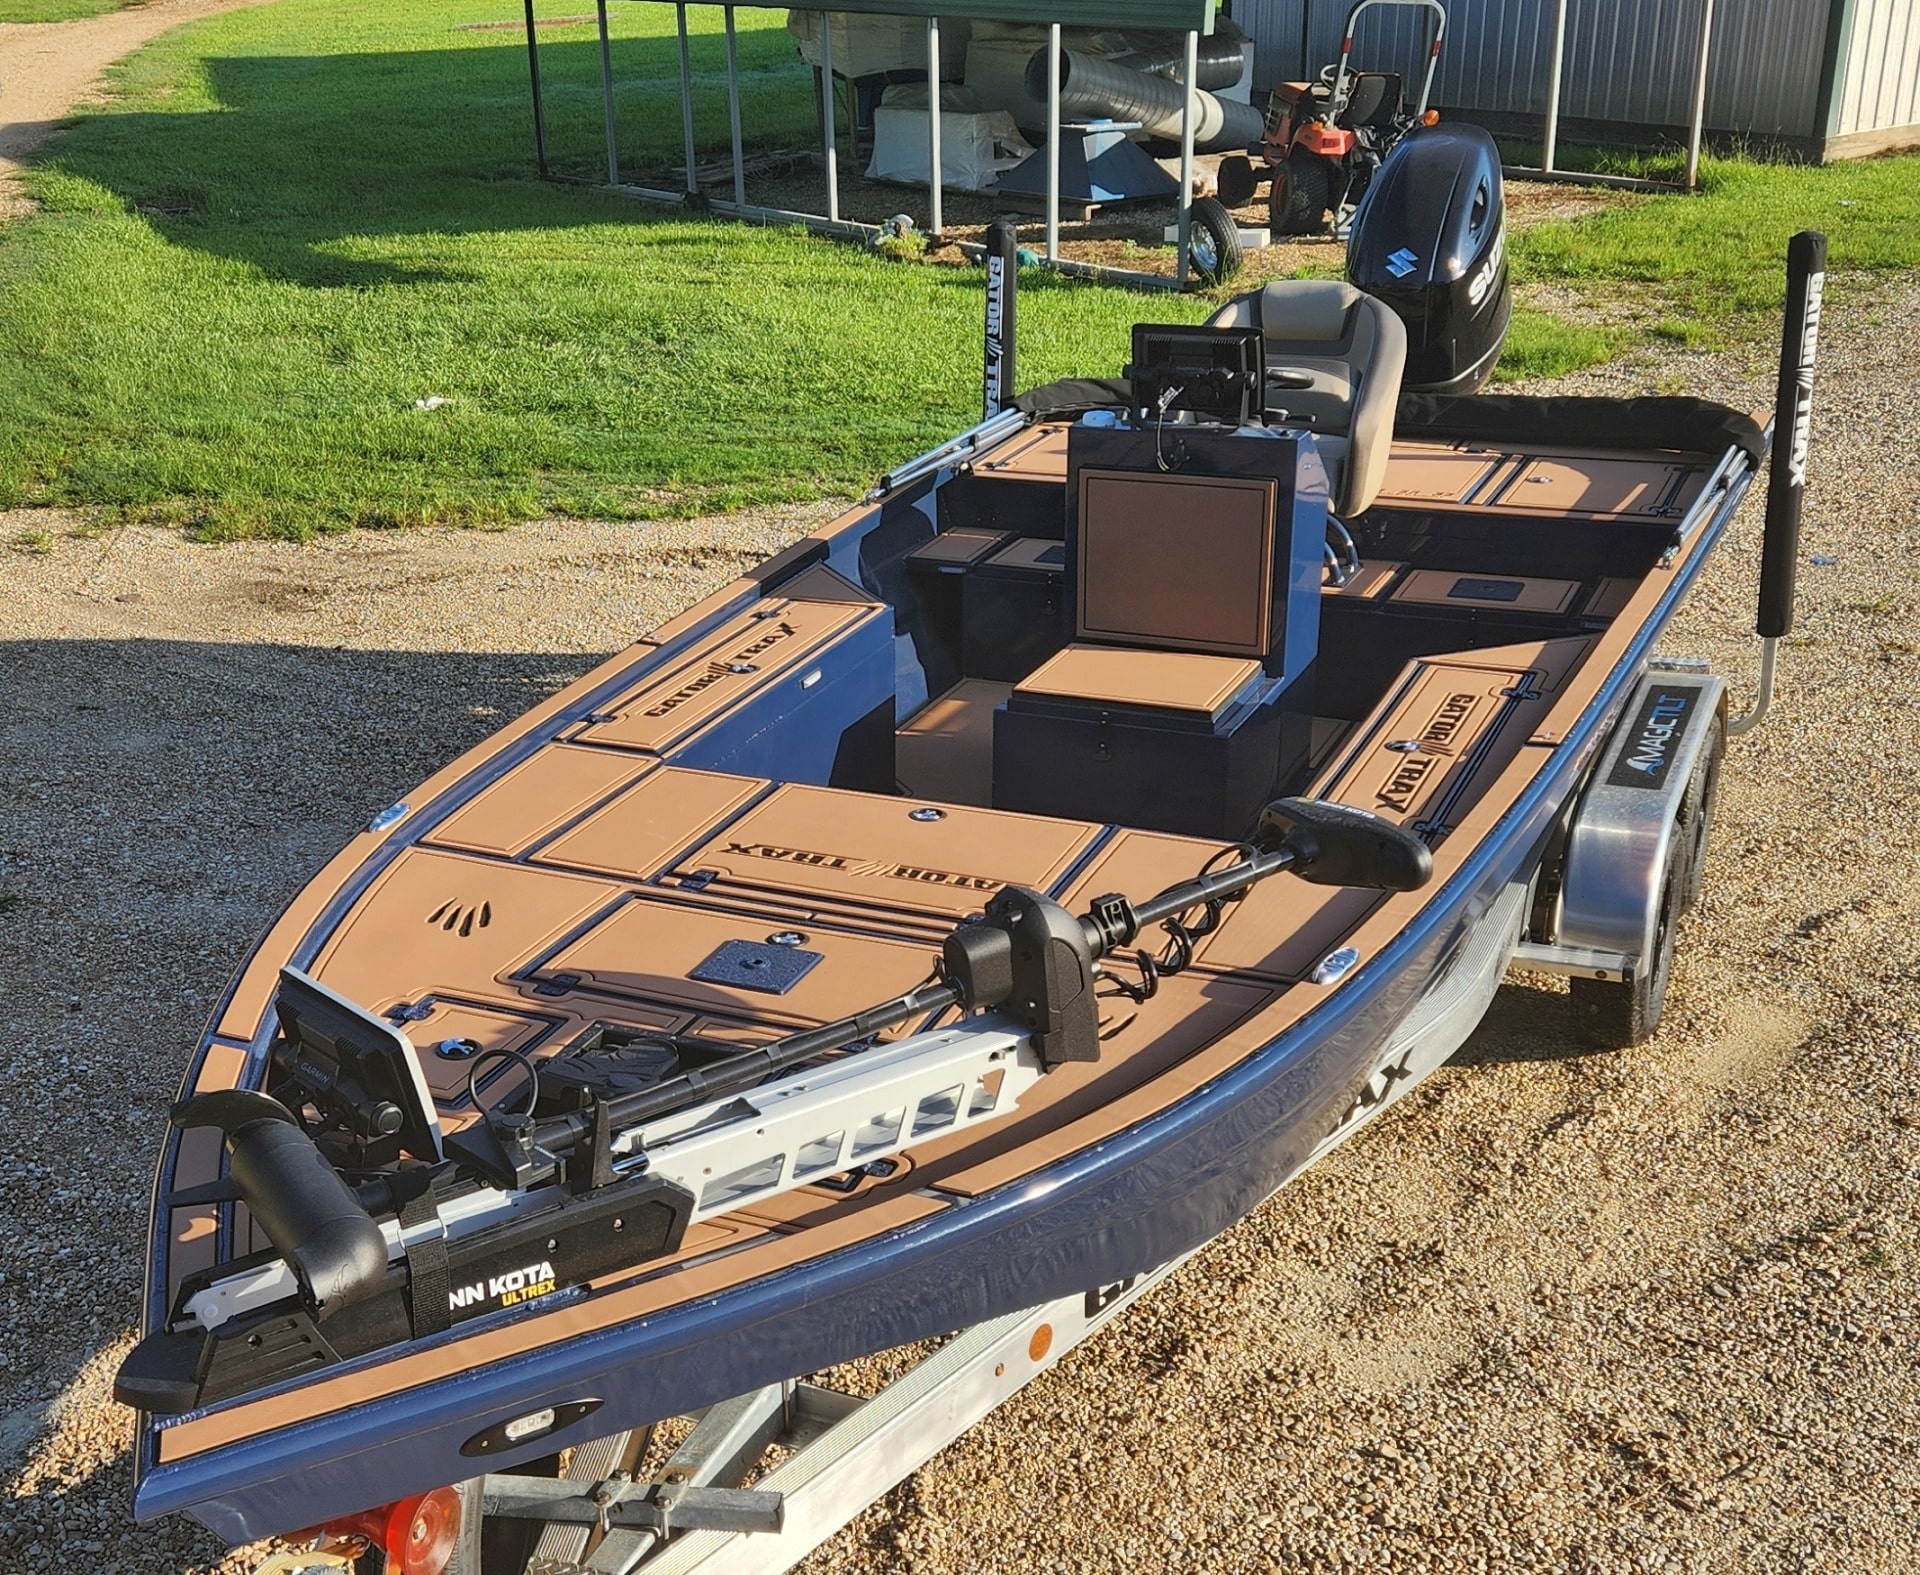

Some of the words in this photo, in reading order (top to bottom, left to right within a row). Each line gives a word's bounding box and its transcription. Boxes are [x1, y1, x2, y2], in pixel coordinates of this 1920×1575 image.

[986, 255, 1001, 336] GATOR
[985, 359, 1000, 420] TRA
[736, 622, 801, 661] TRAX
[1422, 693, 1477, 742] GATOR
[1375, 757, 1432, 813] TRAX
[716, 842, 848, 870] TRAX
[896, 865, 1001, 890] ATOR
[301, 1062, 330, 1085] GARMIN
[449, 1282, 484, 1310] NN
[488, 1261, 556, 1298] KOTA
[502, 1279, 557, 1307] ULTREX
